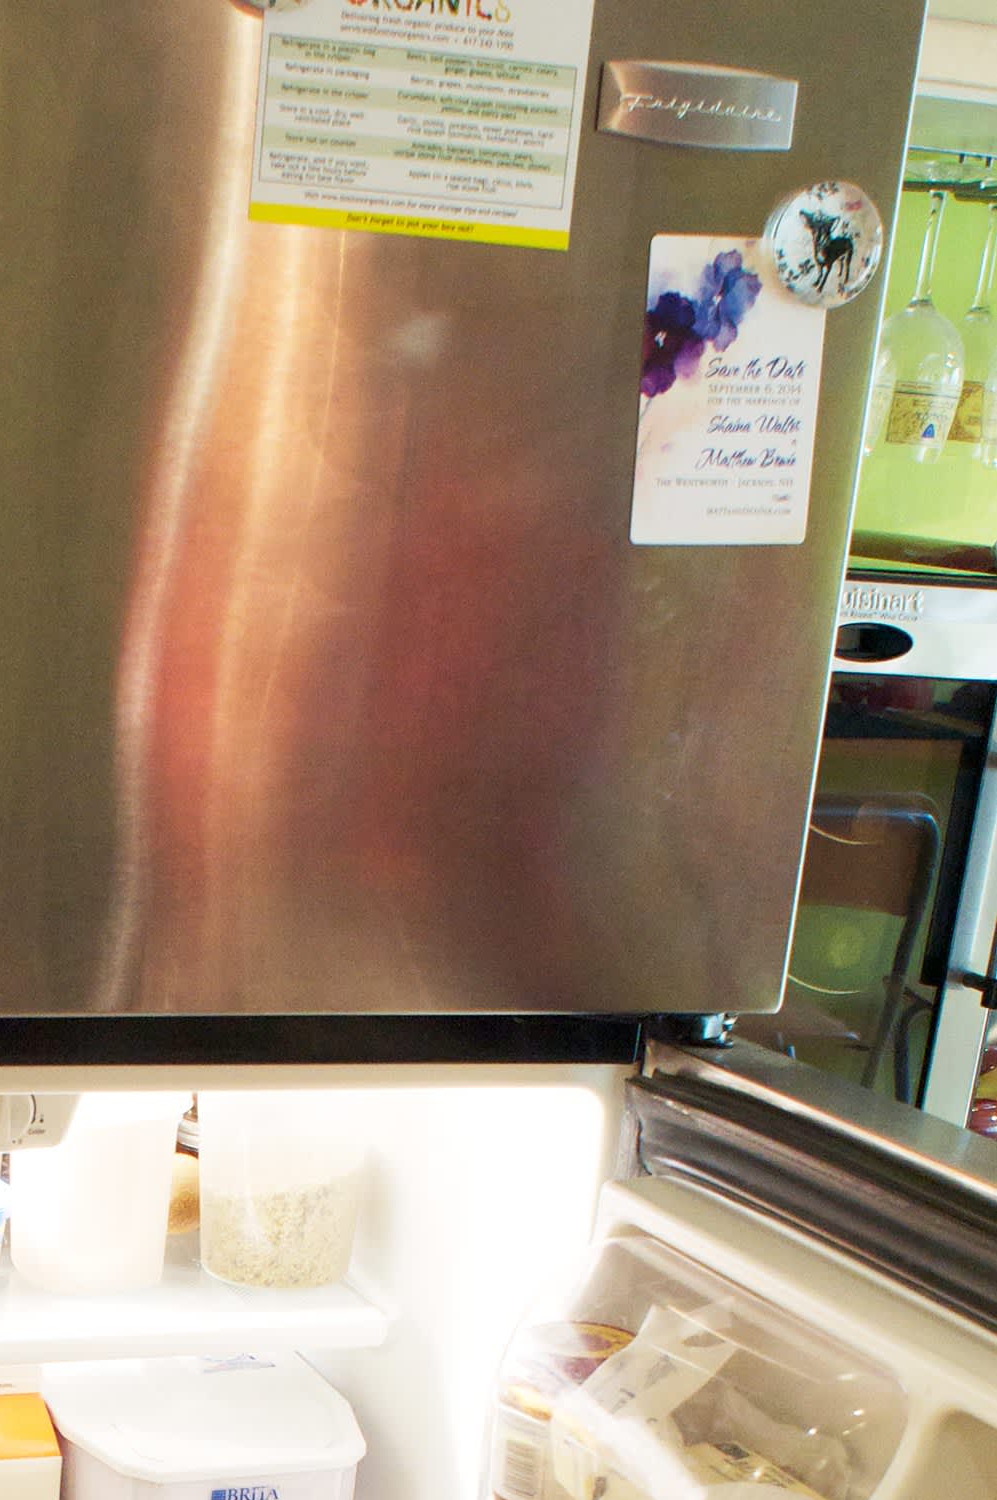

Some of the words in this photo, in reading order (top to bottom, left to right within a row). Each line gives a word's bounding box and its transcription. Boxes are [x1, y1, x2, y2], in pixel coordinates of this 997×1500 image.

[706, 356, 739, 379] Save
[742, 356, 762, 380] the
[766, 356, 807, 379] Date
[844, 588, 924, 611] uisinart
